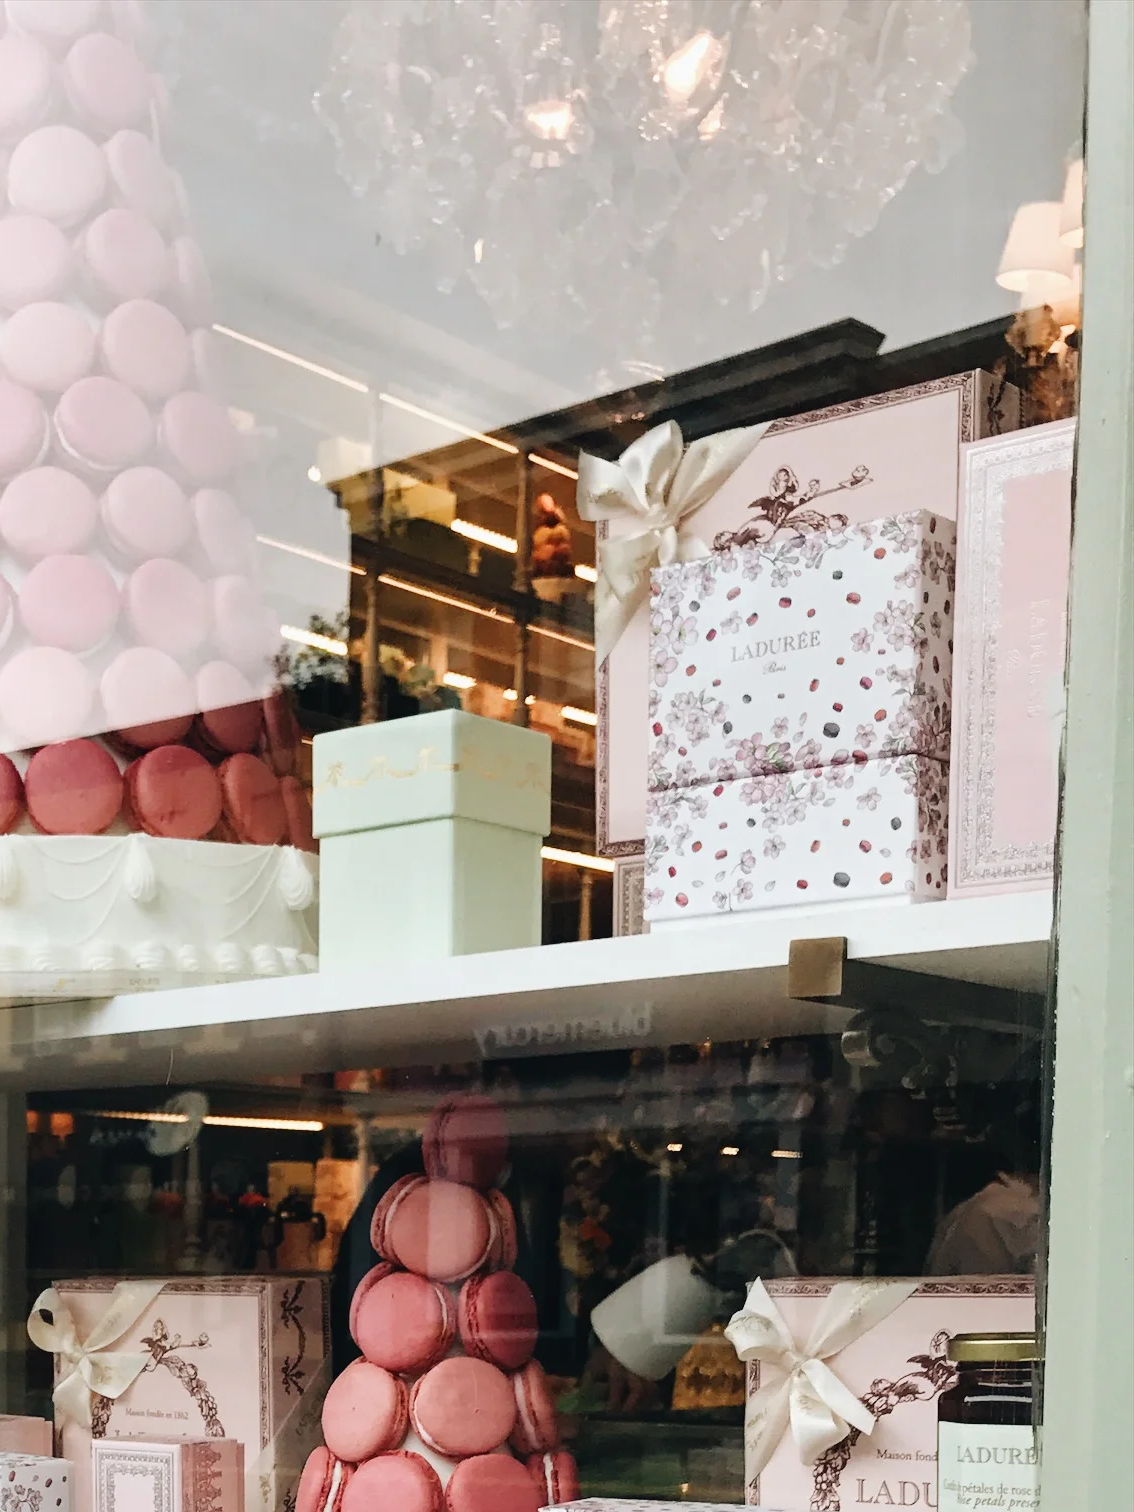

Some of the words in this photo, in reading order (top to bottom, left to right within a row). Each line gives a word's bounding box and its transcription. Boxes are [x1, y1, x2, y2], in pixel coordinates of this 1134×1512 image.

[731, 630, 821, 662] LADURÉE
[876, 1448, 912, 1461] Maison
[915, 1451, 938, 1462] fond
[855, 1478, 938, 1508] LADU
[962, 1482, 994, 1497] pétales
[997, 1482, 1009, 1495] de
[1011, 1487, 1032, 1496] rose
[973, 1495, 1006, 1509] petals
